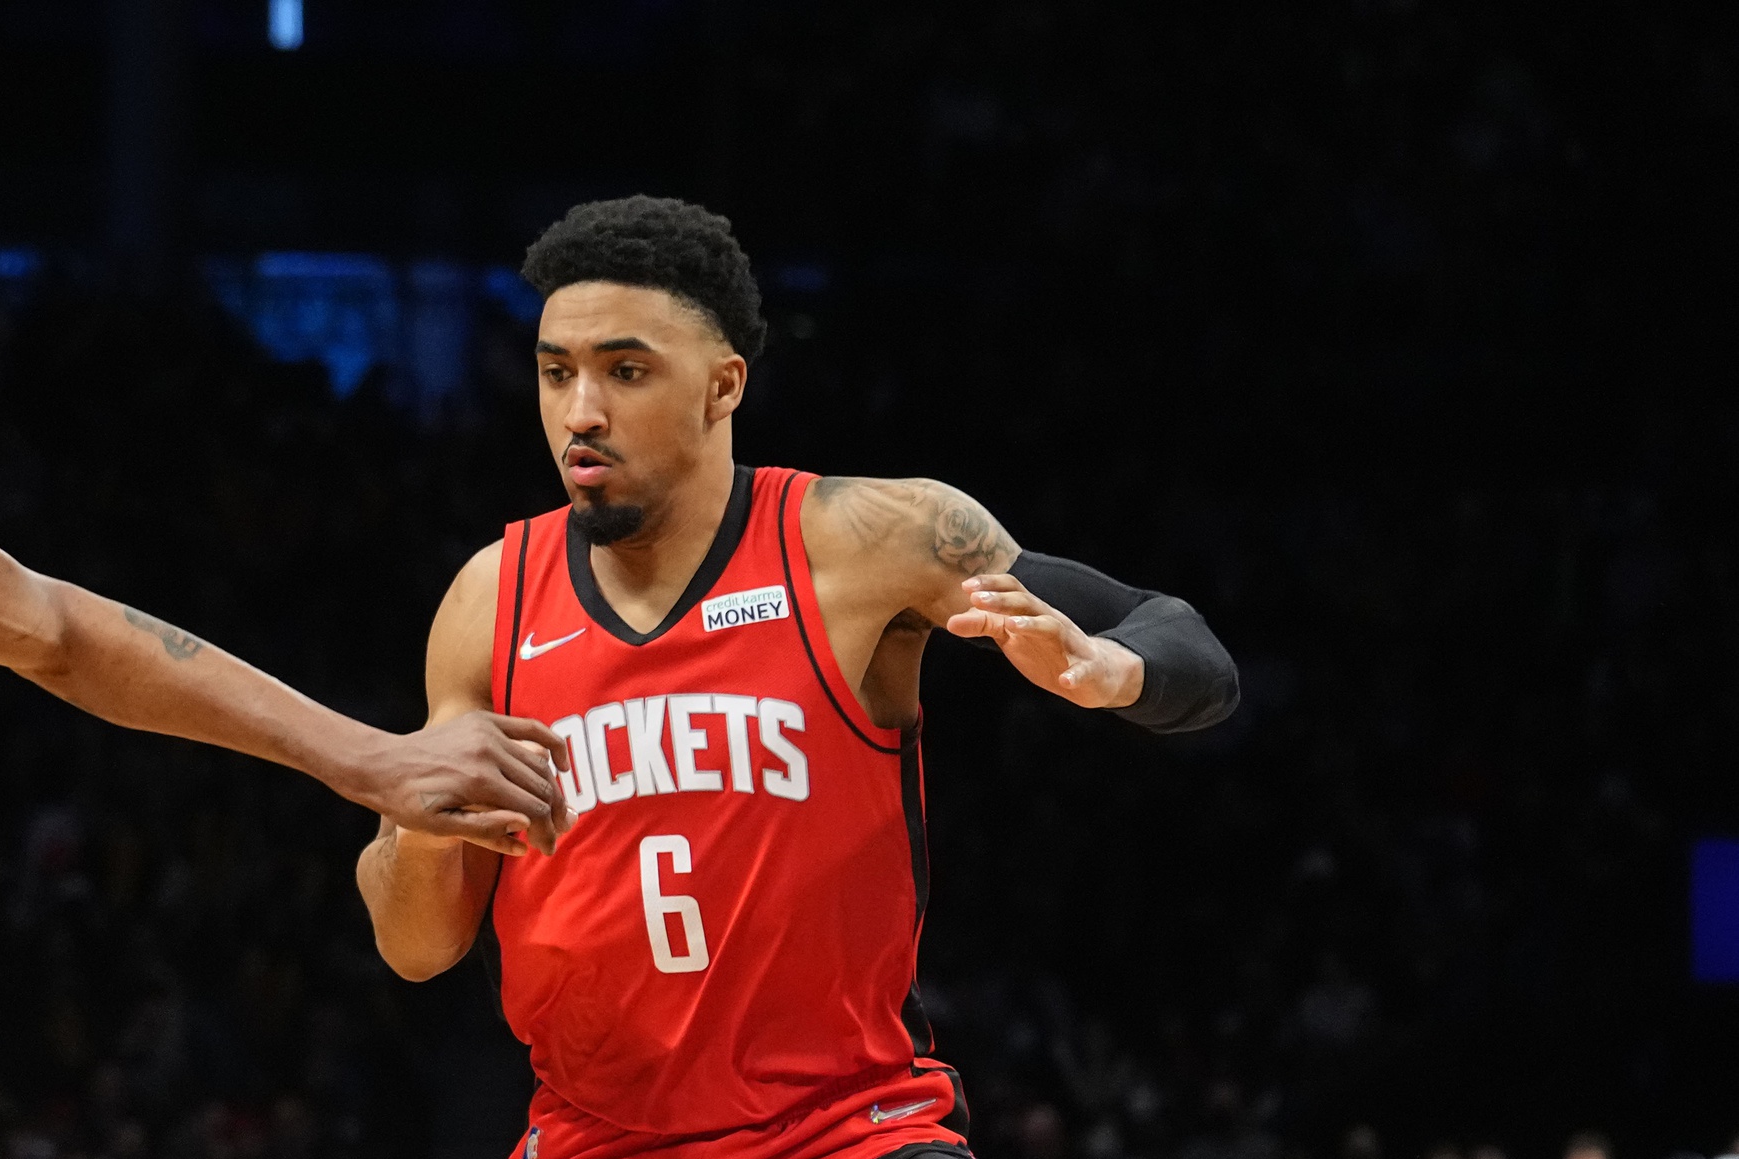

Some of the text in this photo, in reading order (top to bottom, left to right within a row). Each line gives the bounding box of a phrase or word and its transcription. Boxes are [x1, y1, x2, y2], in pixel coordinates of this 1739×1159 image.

[706, 590, 783, 612] credit karma
[707, 600, 783, 630] MONEY
[548, 693, 810, 814] OCKETS
[639, 834, 709, 974] 6
